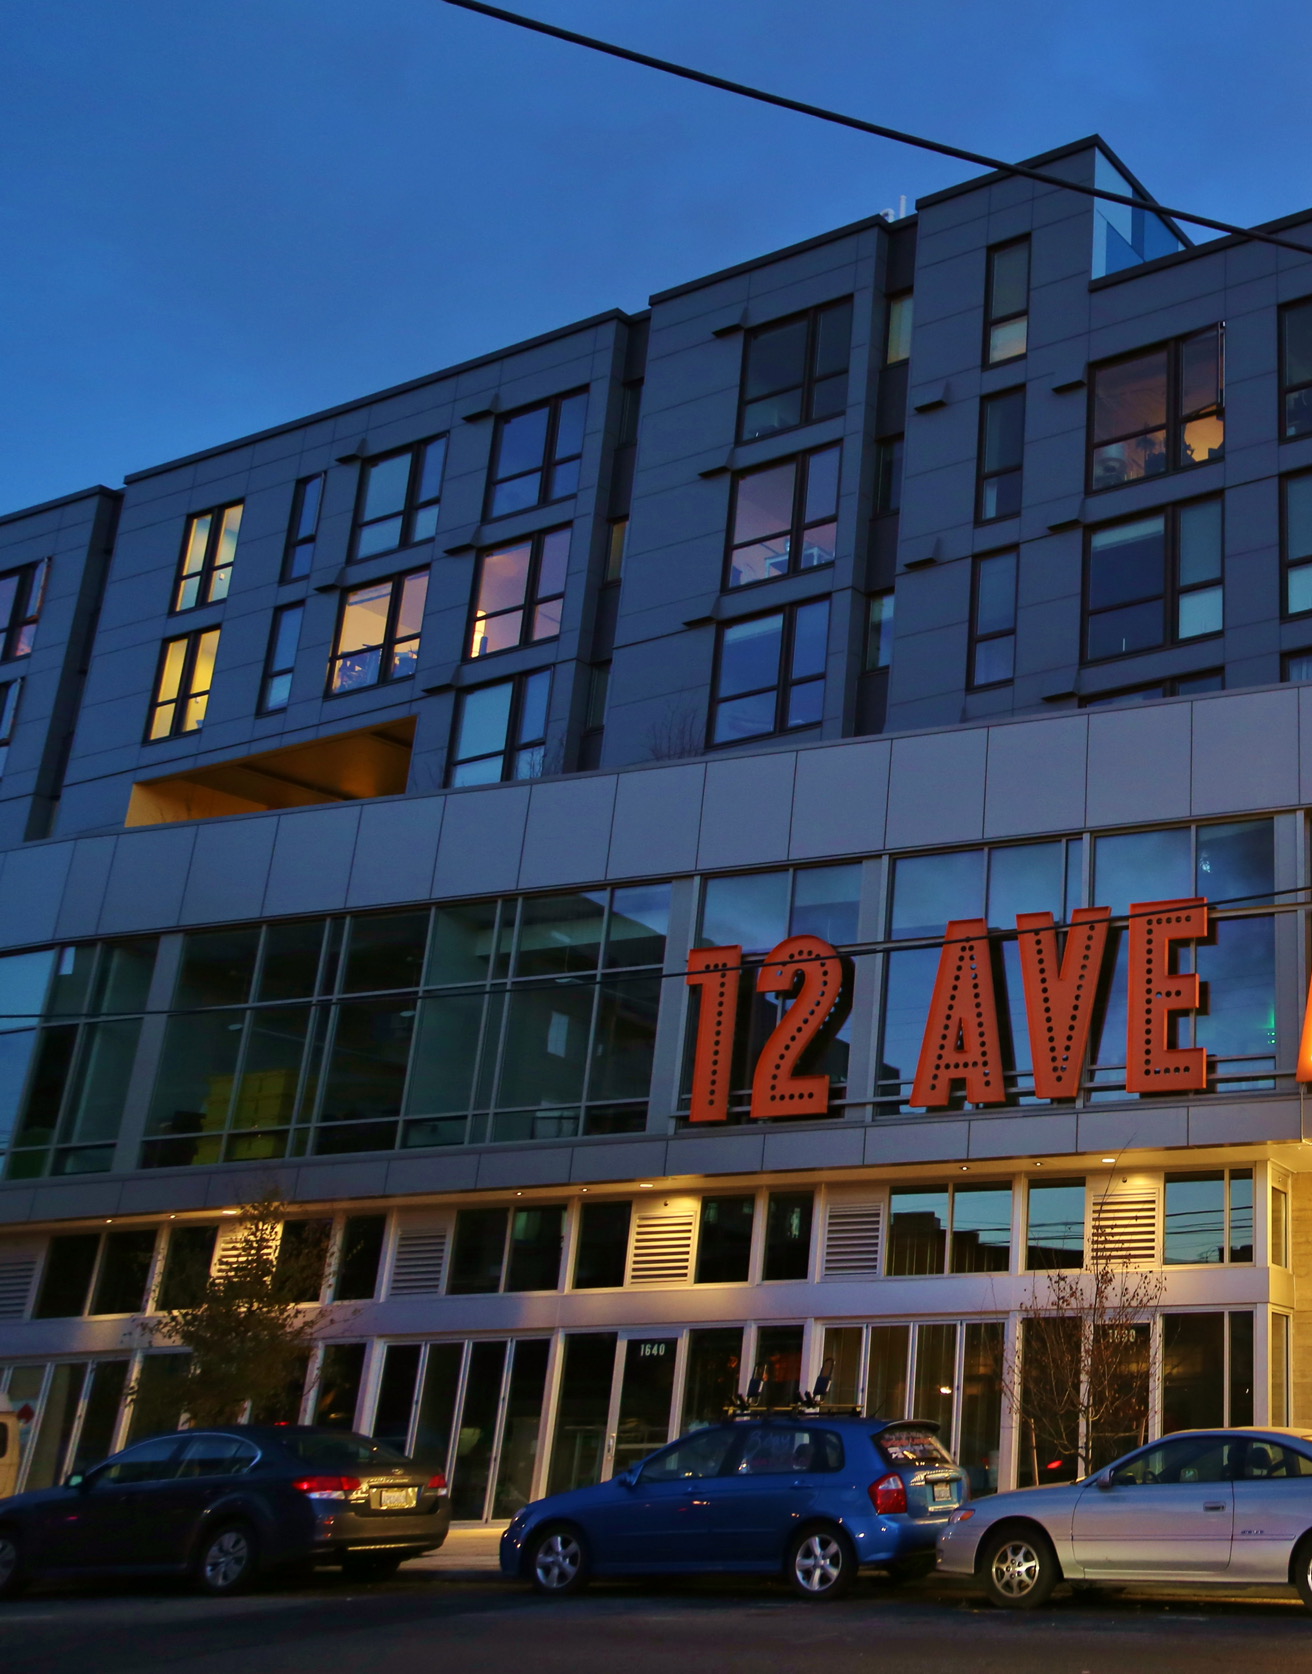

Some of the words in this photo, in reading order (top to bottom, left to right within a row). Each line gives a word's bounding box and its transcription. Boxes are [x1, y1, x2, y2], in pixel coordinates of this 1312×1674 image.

[686, 934, 843, 1121] 12
[909, 897, 1208, 1107] AVE
[640, 1343, 666, 1357] 1640
